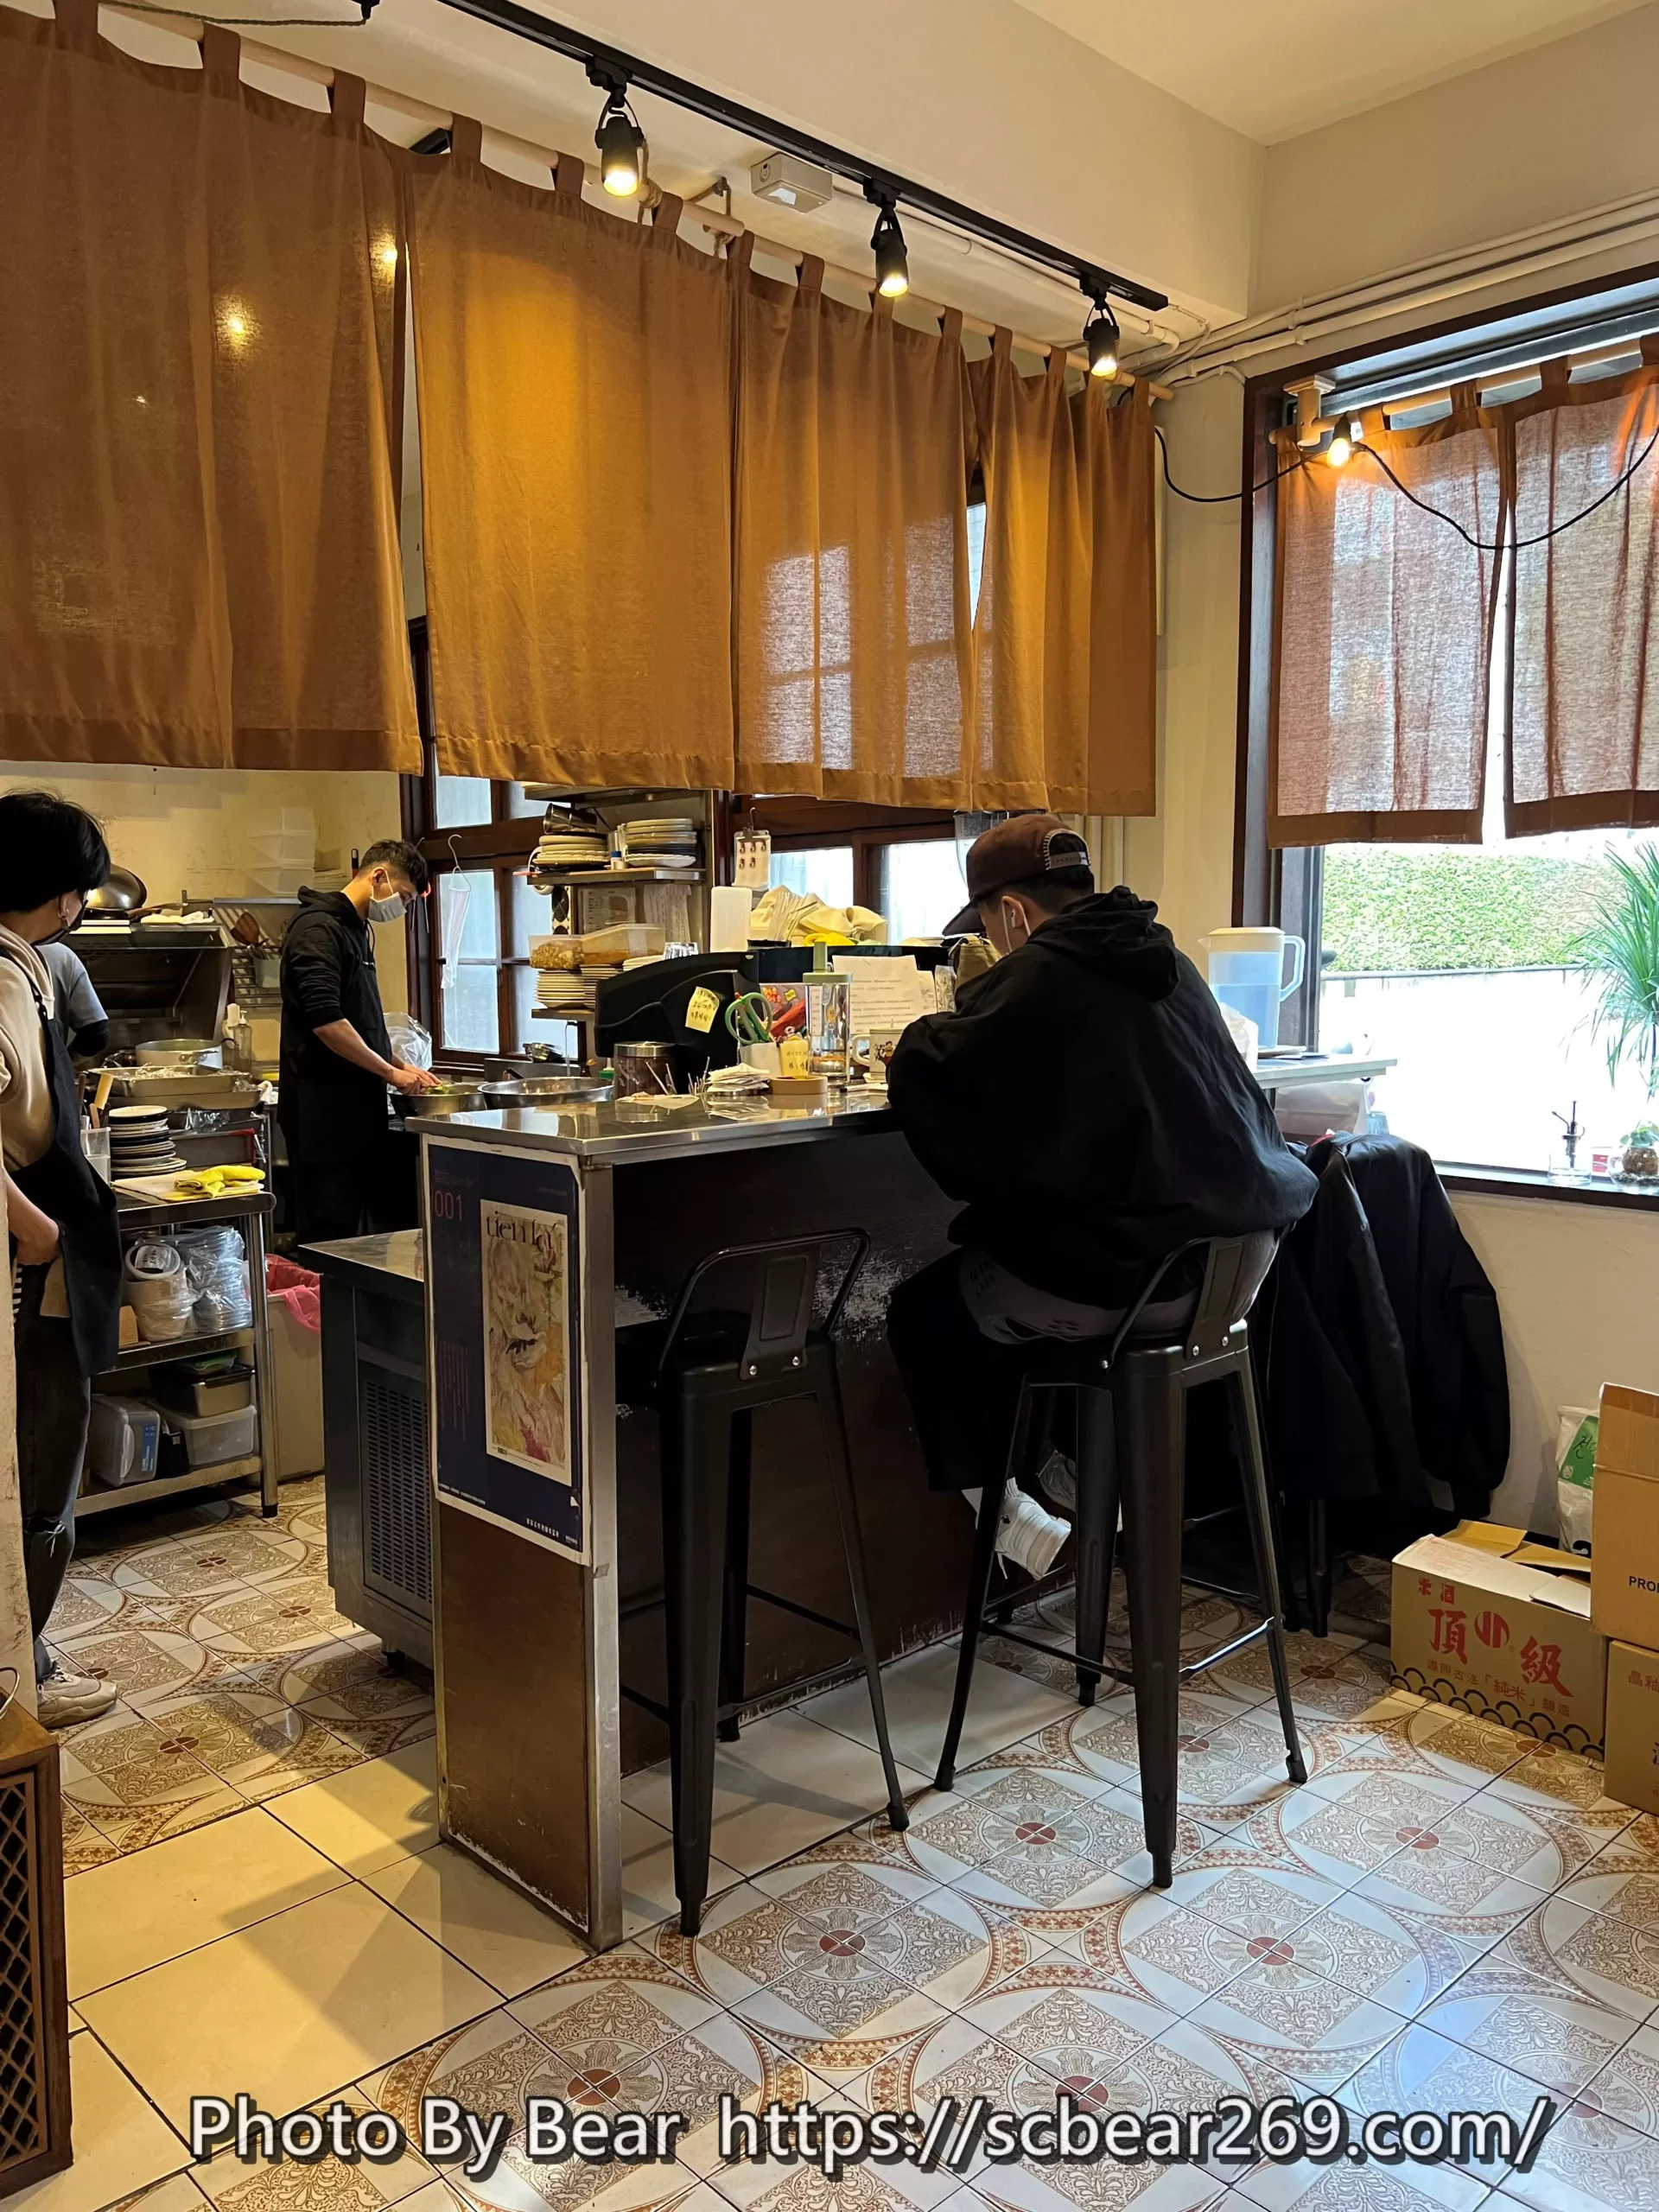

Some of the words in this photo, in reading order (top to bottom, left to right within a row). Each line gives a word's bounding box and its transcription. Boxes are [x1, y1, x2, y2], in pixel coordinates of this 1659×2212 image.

[435, 1190, 462, 1222] 001
[1418, 1577, 1455, 1605] 米酒
[1629, 1575, 1659, 1593] PRO
